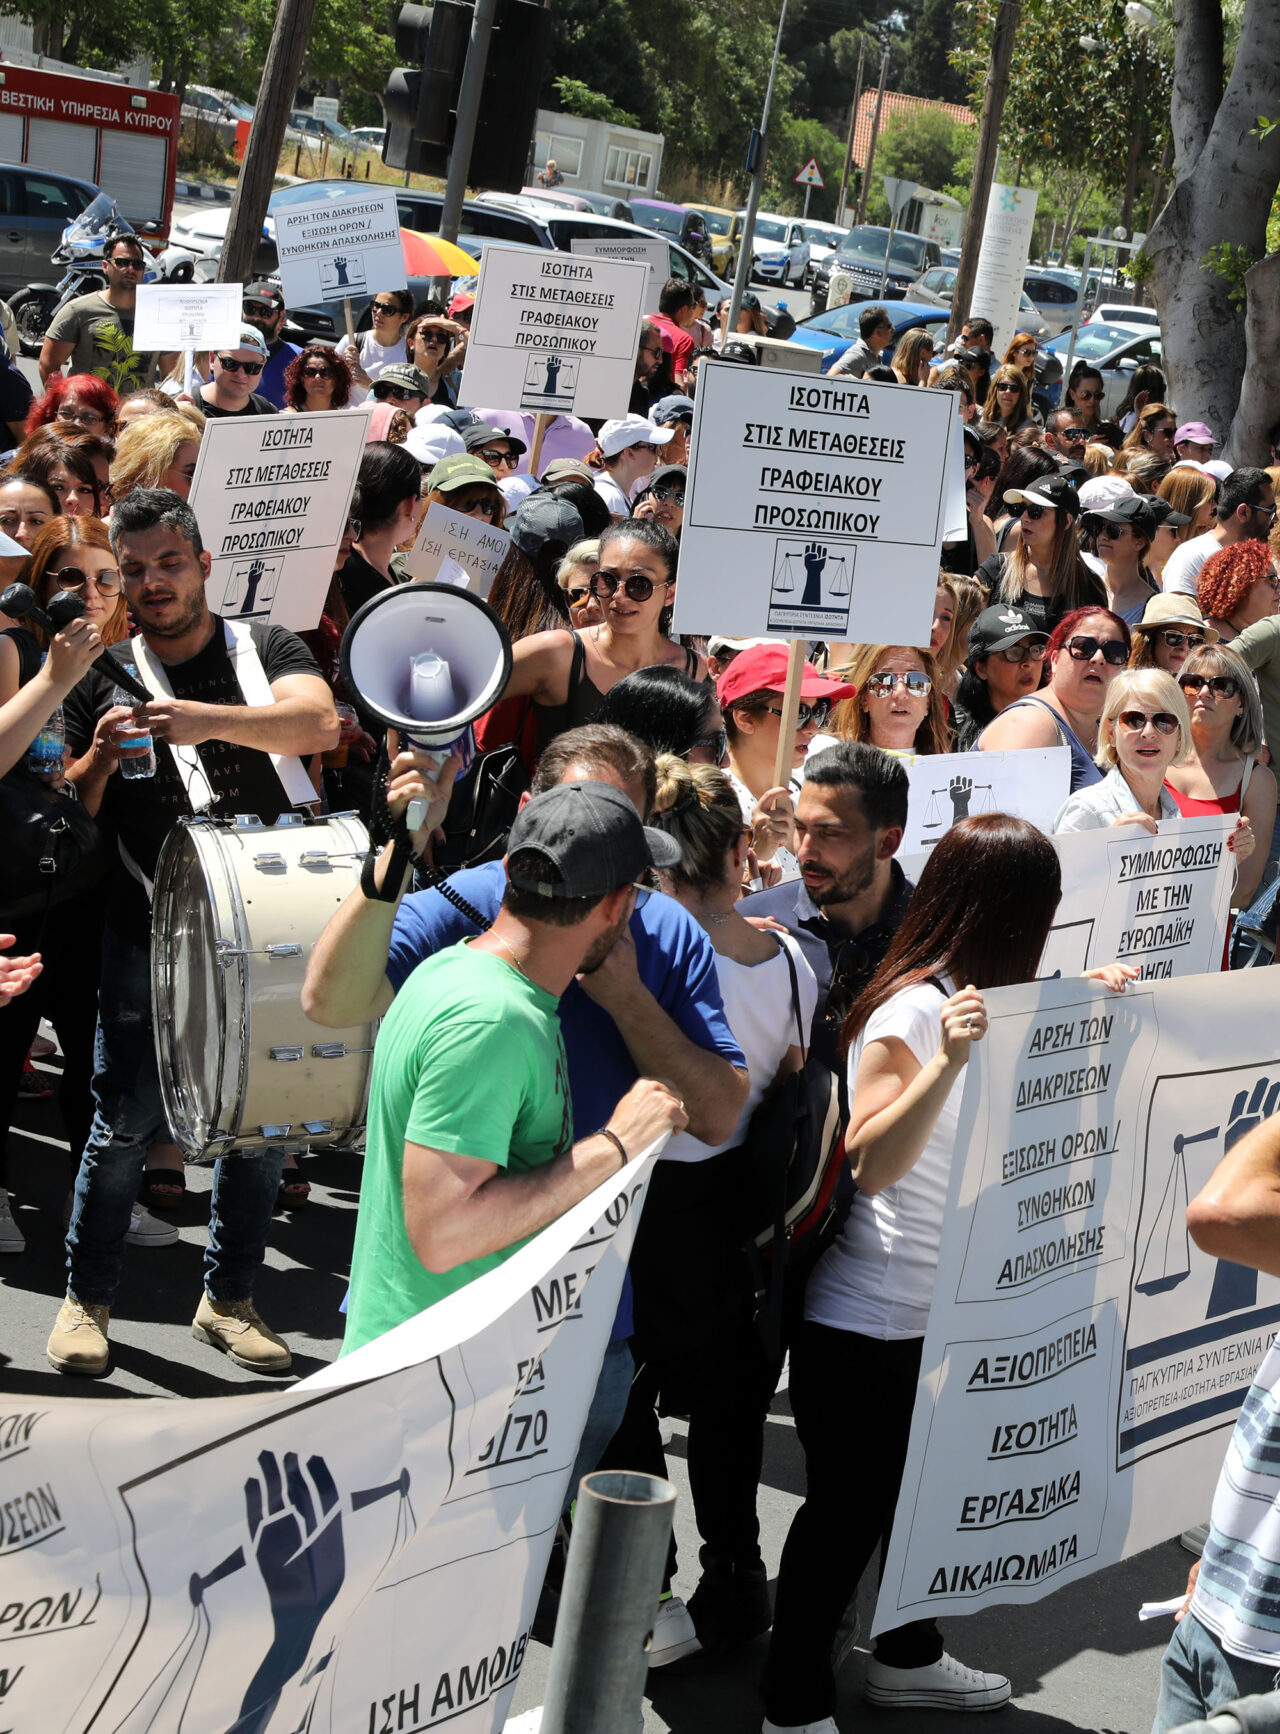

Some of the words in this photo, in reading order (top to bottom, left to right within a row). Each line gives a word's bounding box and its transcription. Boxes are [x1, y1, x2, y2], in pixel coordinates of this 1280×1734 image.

[0, 90, 54, 112] ΒΕΣΤΙΚΗ
[61, 100, 120, 122] ΥΠΗΡΕΣΙΑ
[125, 112, 172, 131] ΚΥΠΡΟΥ
[287, 214, 309, 225] ΑΡΣΗ
[312, 212, 330, 221] ΤΩΝ
[332, 203, 384, 218] ΔΙΑΚΡΙΣΕΩΝ
[302, 225, 337, 238] ΕΞΙΣΩΣΗ
[339, 221, 365, 232] ΟΡΩΝ
[282, 239, 330, 255] ΣΥΝΘΗΚΩΝ
[332, 230, 396, 246] ΑΠΑΣΧΟΛΗΣΗΣ
[541, 262, 592, 279] ΙΣΟΤΗΤΑ
[511, 284, 536, 298] ΣΤΙΣ
[540, 287, 615, 306] ΜΕΤΑΘΕΣΕΙΣ
[520, 310, 599, 329] ΓΡΑΦΕΙΑΚΟΥ
[515, 332, 596, 352] ΠΡΟΣΩΠΙΚΟΥ
[790, 386, 870, 414] ΙΣΟΤΗΤΑ
[262, 428, 313, 447] ΙΣΟΤΗΤΑ
[744, 423, 783, 446] ΣΤΙΣ
[788, 428, 906, 458] ΜΕΤΑΘΕΣΕΙΣ
[226, 467, 254, 486] ΣΤΙΣ
[255, 461, 332, 483] ΜΕΤΑΘΕΣΕΙΣ
[760, 467, 882, 497] ΓΡΑΦΕΙΑΚΟΥ
[231, 496, 311, 520] ΓΡΑΦΕΙΑΚΟΥ
[754, 504, 880, 534] ΠΡΟΣΩΠΙΚΟΥ
[221, 528, 304, 552] ΠΡΟΣΩΠΙΚΟΥ
[444, 520, 470, 540] ΙΣΗ
[421, 538, 442, 557] ΙΣΗ
[448, 548, 498, 573] ΕΡΓΑΣΙΑ
[1004, 622, 1030, 633] adidas
[1119, 842, 1222, 878] ΣΥΜΜΟΡΦΩΣΗ
[1136, 888, 1159, 912] ΜΕ
[1164, 884, 1192, 908] ΤΗΝ
[1118, 917, 1194, 952] ΕΥΡΩΠΑΪΚΗ
[1029, 1022, 1075, 1054] ΑΡΣΗ
[1080, 1015, 1114, 1040] ΤΩΝ
[1016, 1063, 1111, 1108] ΔΙΑΚΡΙΣΕΩΝ
[1002, 1138, 1056, 1181] ΕΞΙΣΩΣΗ
[1062, 1126, 1108, 1160] ΟΡΩΝ
[1111, 1120, 1122, 1152] /
[1018, 1178, 1096, 1228] ΣΥΝΘΗΚΩΝ
[996, 1225, 1106, 1284] ΑΠΑΣΧΟΛΗΣΗΣ
[968, 1324, 1098, 1386] ΑΞΙΟΠΡΕΠΕΙΑ
[1130, 1357, 1194, 1396] ΠΑΓΚΥΠΡΙΑ
[1197, 1336, 1262, 1372] ΣΥΝΤΕΧΝΙΑ
[0, 1411, 50, 1449] ΩΝ
[991, 1402, 1078, 1454] ΙΣΟΤΗΤΑ
[960, 1470, 1080, 1525] ΕΡΓΑΣΙΑΚΑ
[0, 1482, 62, 1549] ΣΕΩΝ
[928, 1534, 1078, 1596] ΔΙΚΑΙΩΜΑΤΑ
[430, 1625, 533, 1718] ΑΜΟΙΒ
